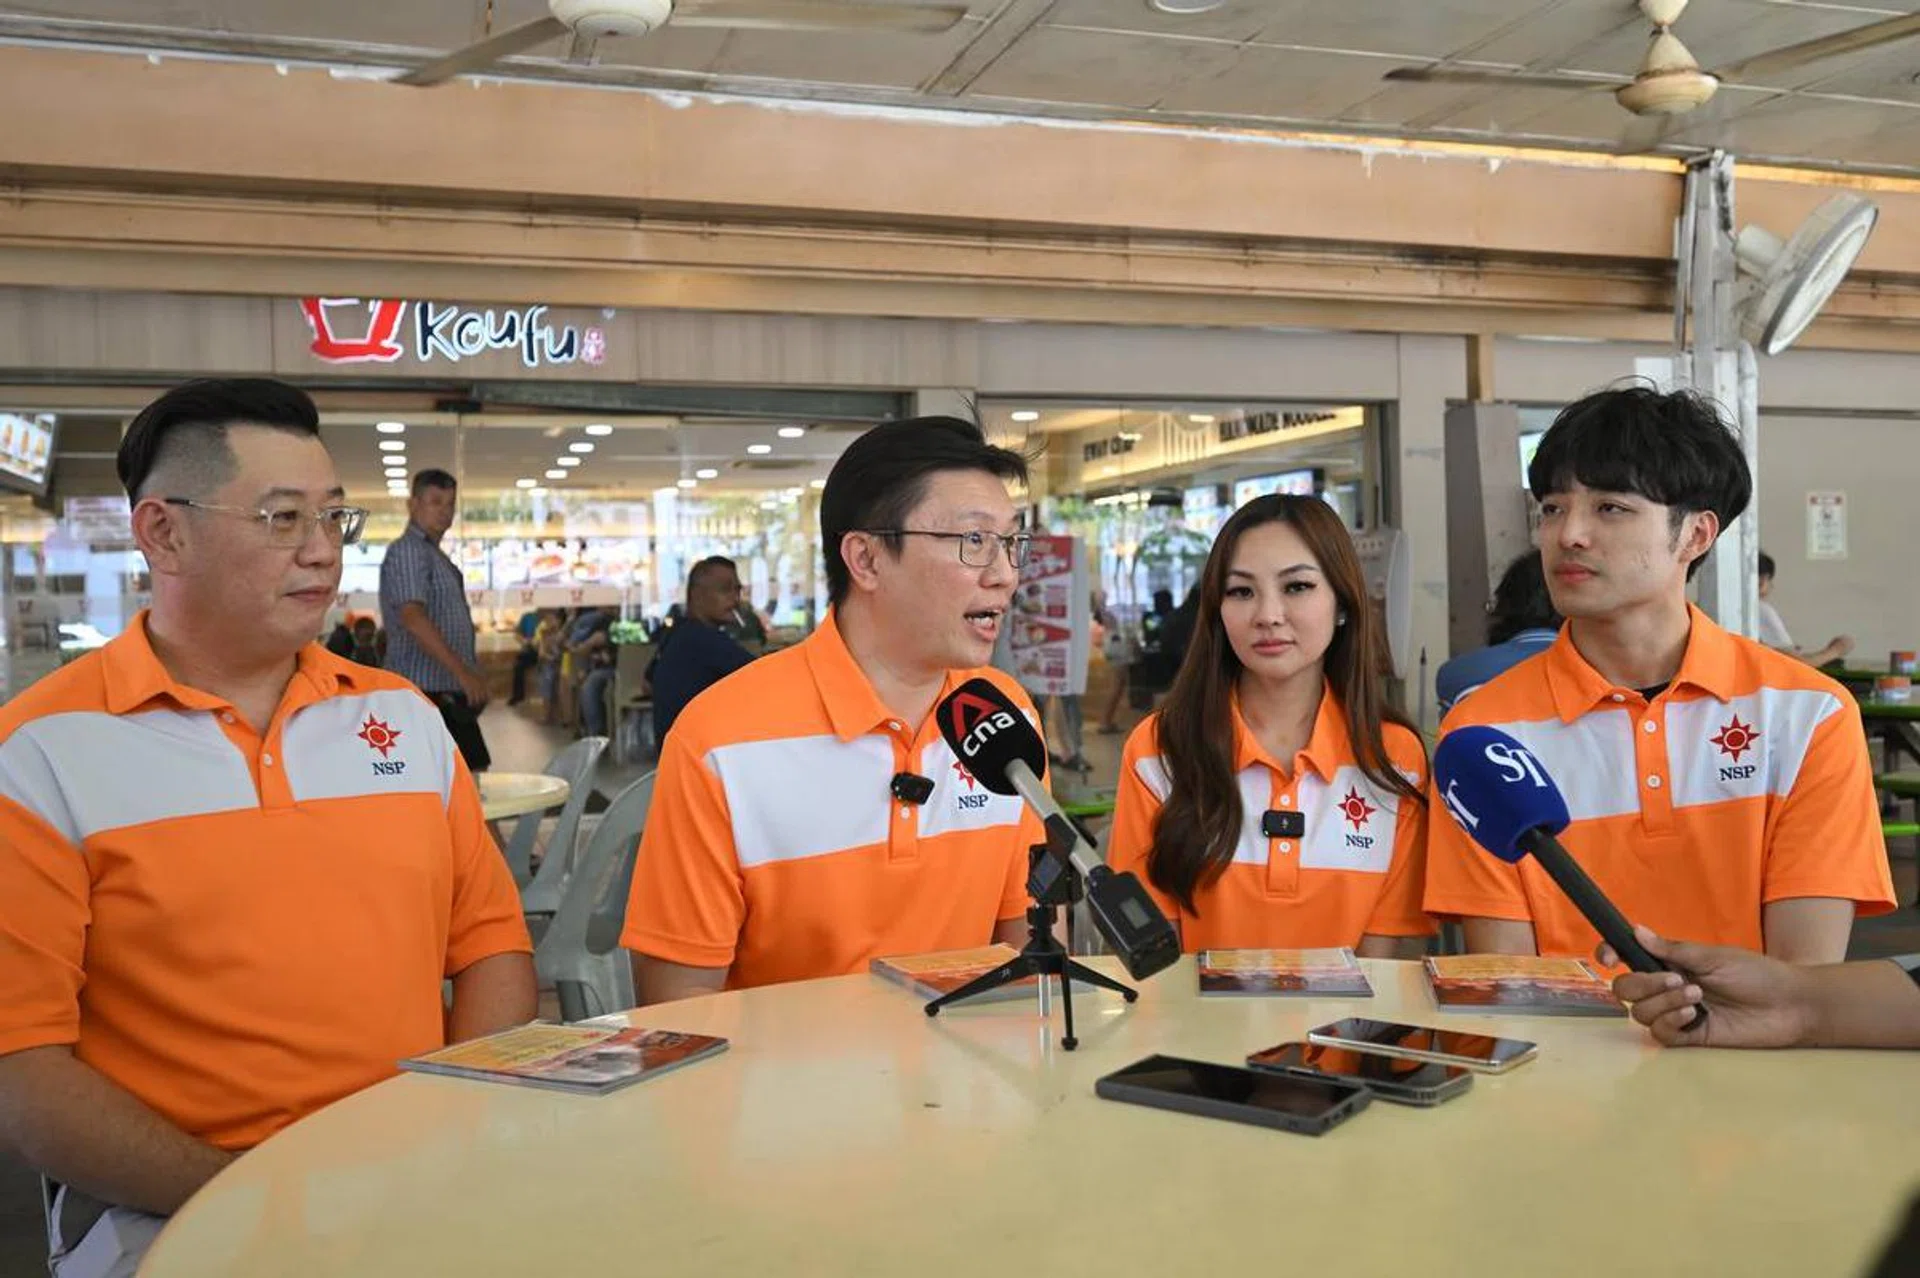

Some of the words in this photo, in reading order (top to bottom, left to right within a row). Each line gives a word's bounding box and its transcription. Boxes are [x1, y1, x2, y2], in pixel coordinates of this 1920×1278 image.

[962, 711, 1016, 757] cna
[371, 761, 406, 776] NSP
[1718, 764, 1756, 781] NSP
[957, 794, 989, 810] NSP
[1345, 833, 1375, 849] NSP
